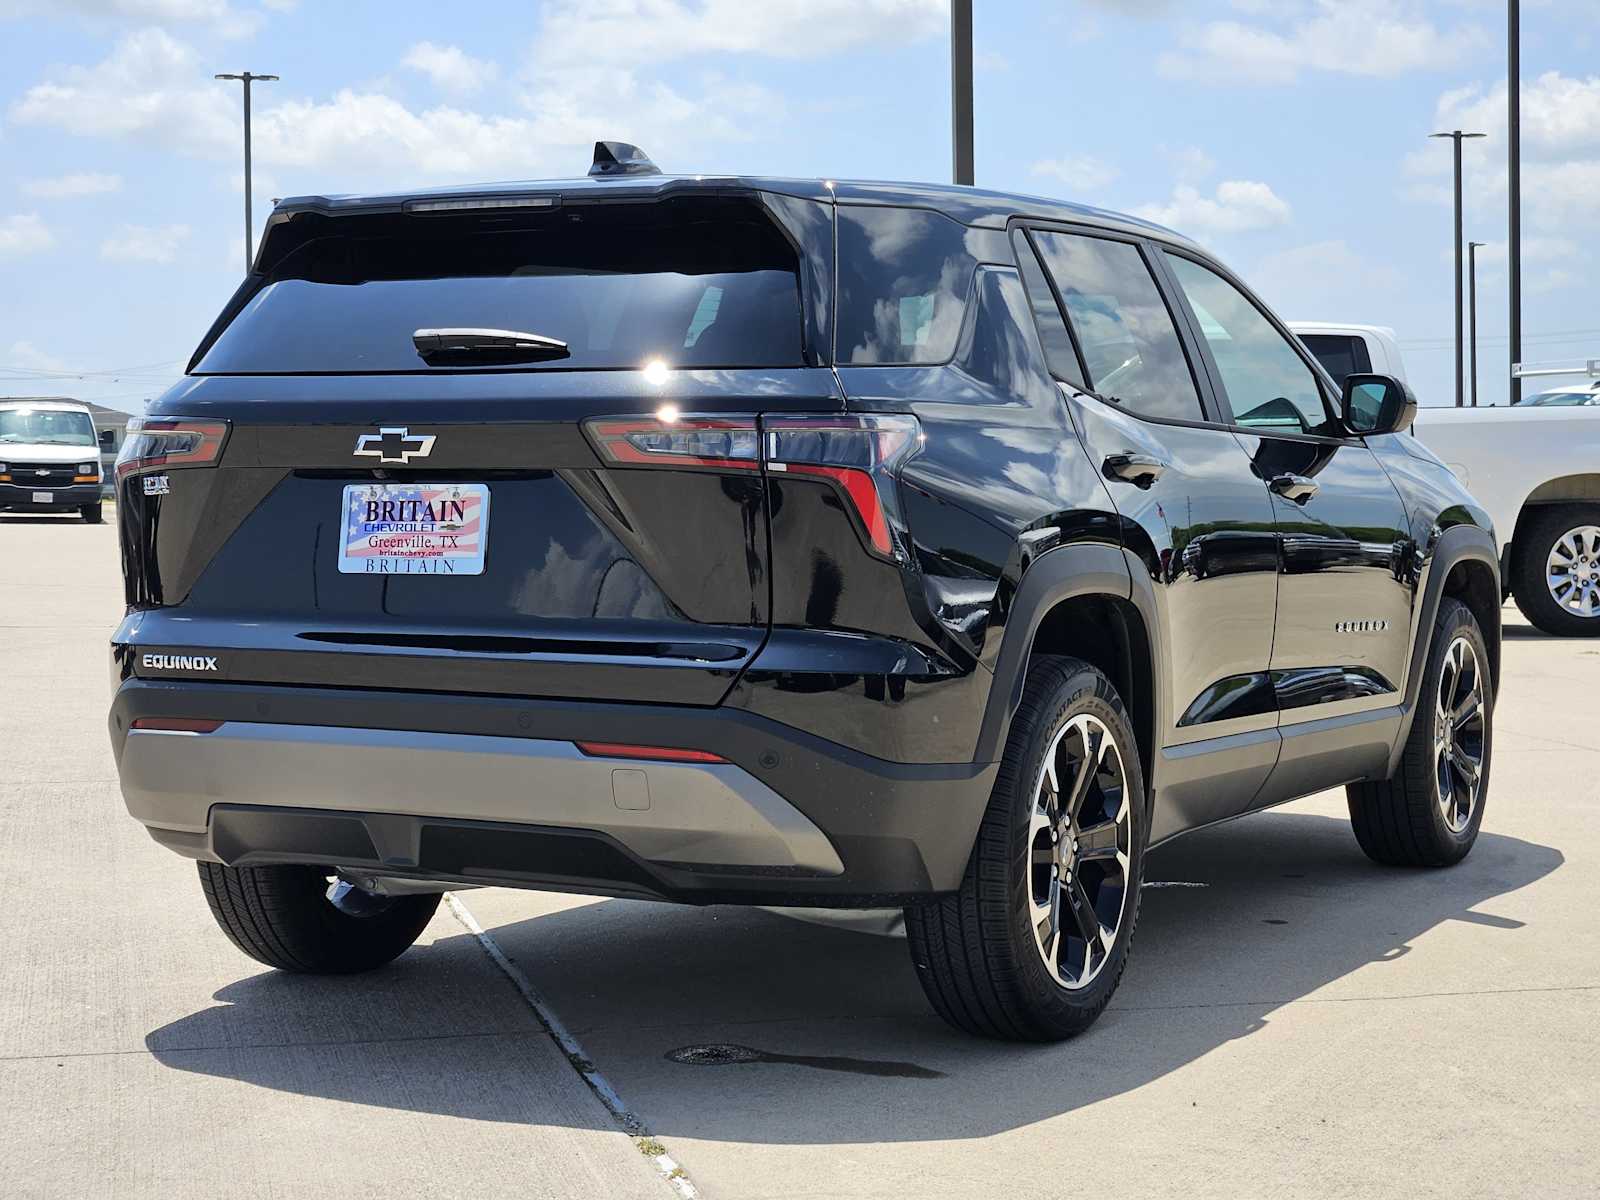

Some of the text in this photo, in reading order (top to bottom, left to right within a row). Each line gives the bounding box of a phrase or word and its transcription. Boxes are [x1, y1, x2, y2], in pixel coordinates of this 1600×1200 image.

[365, 500, 467, 523] BRITAIN
[364, 523, 437, 532] CHEVROLET
[368, 535, 459, 550] Greenville, TX
[379, 549, 444, 558] britainchevy.com
[365, 558, 456, 573] BRITAIN
[1335, 619, 1390, 633] EQUINOX
[142, 654, 218, 671] EQUINOX
